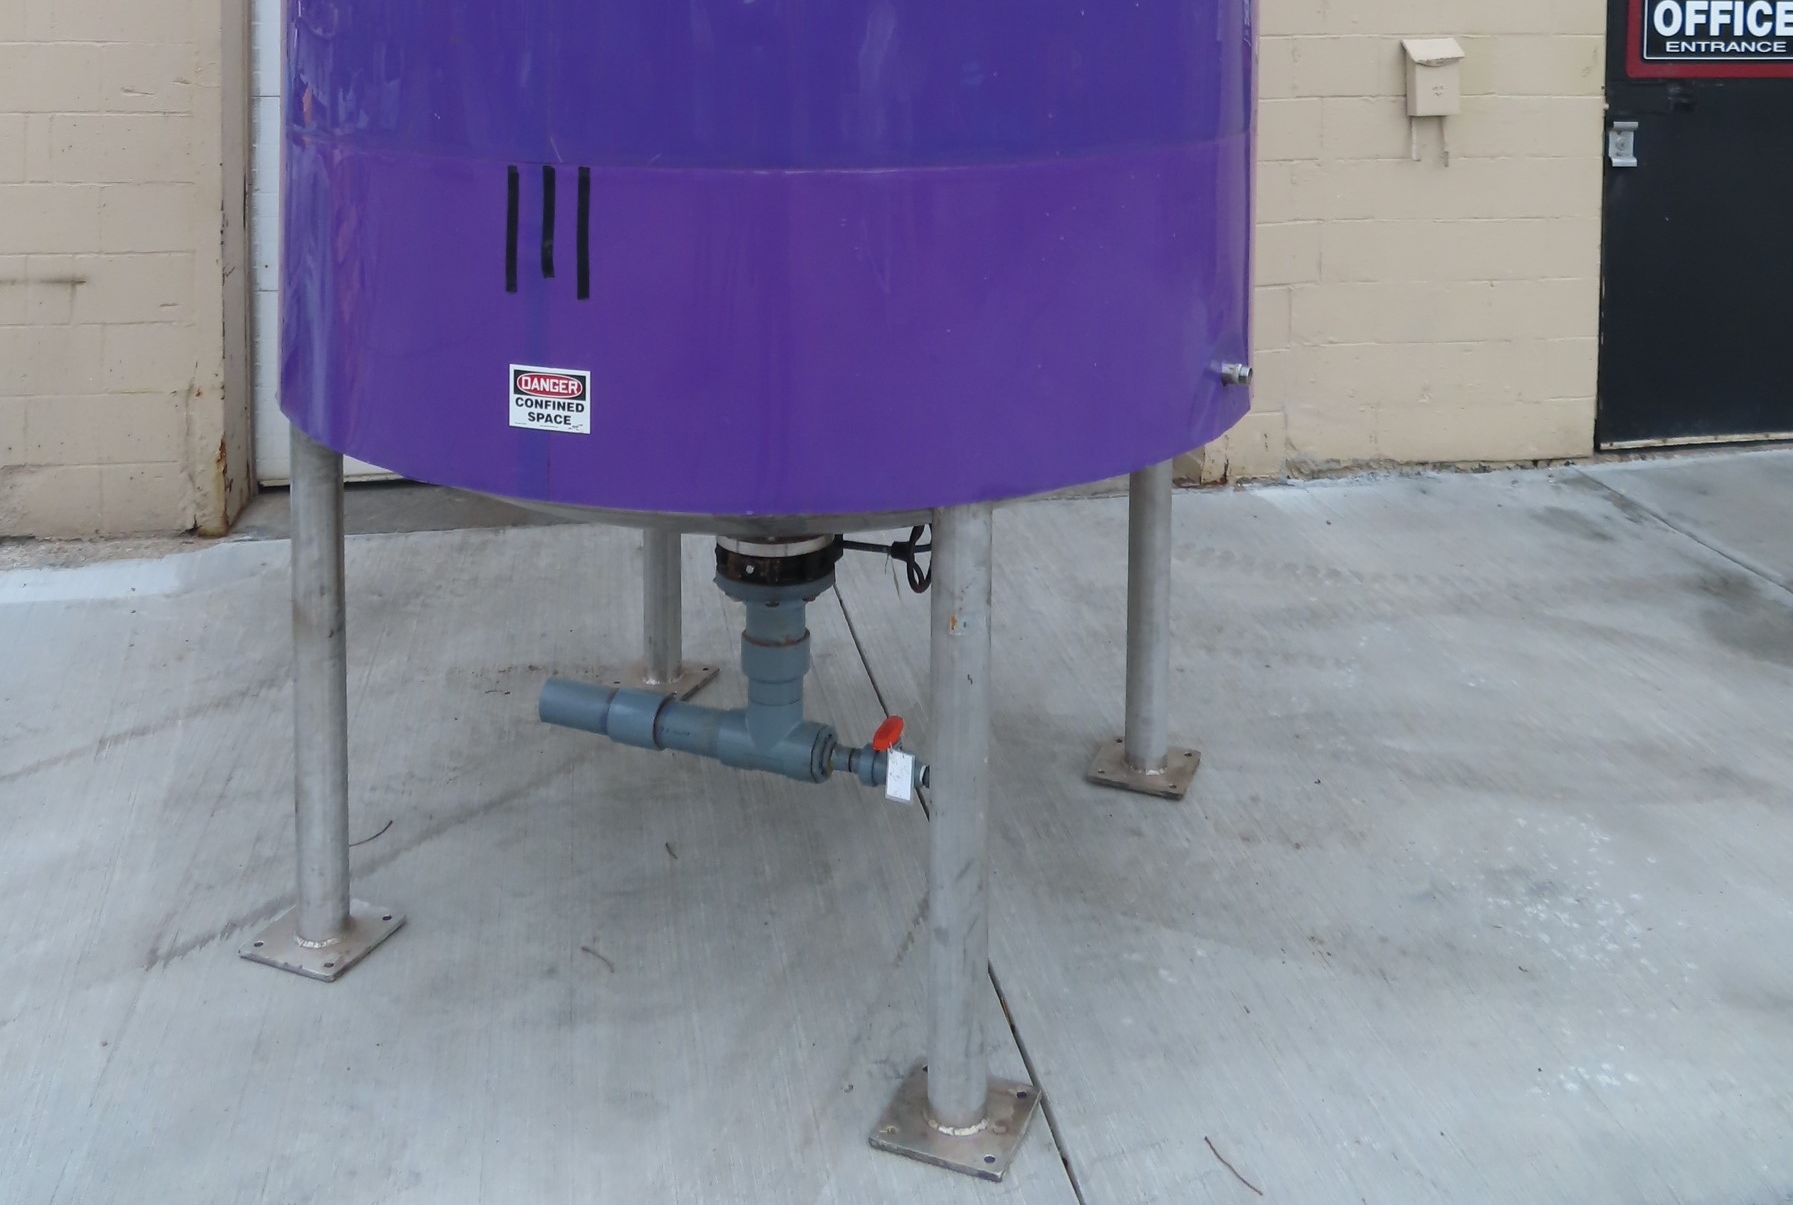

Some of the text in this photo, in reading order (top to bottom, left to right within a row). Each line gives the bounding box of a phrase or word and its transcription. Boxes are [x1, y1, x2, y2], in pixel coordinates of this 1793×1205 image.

[1653, 0, 1793, 37] OFFICE
[1665, 41, 1787, 53] ENTRANCE
[521, 376, 579, 395] DANGER
[515, 396, 585, 413] CONFINED
[527, 411, 572, 426] SPACE
